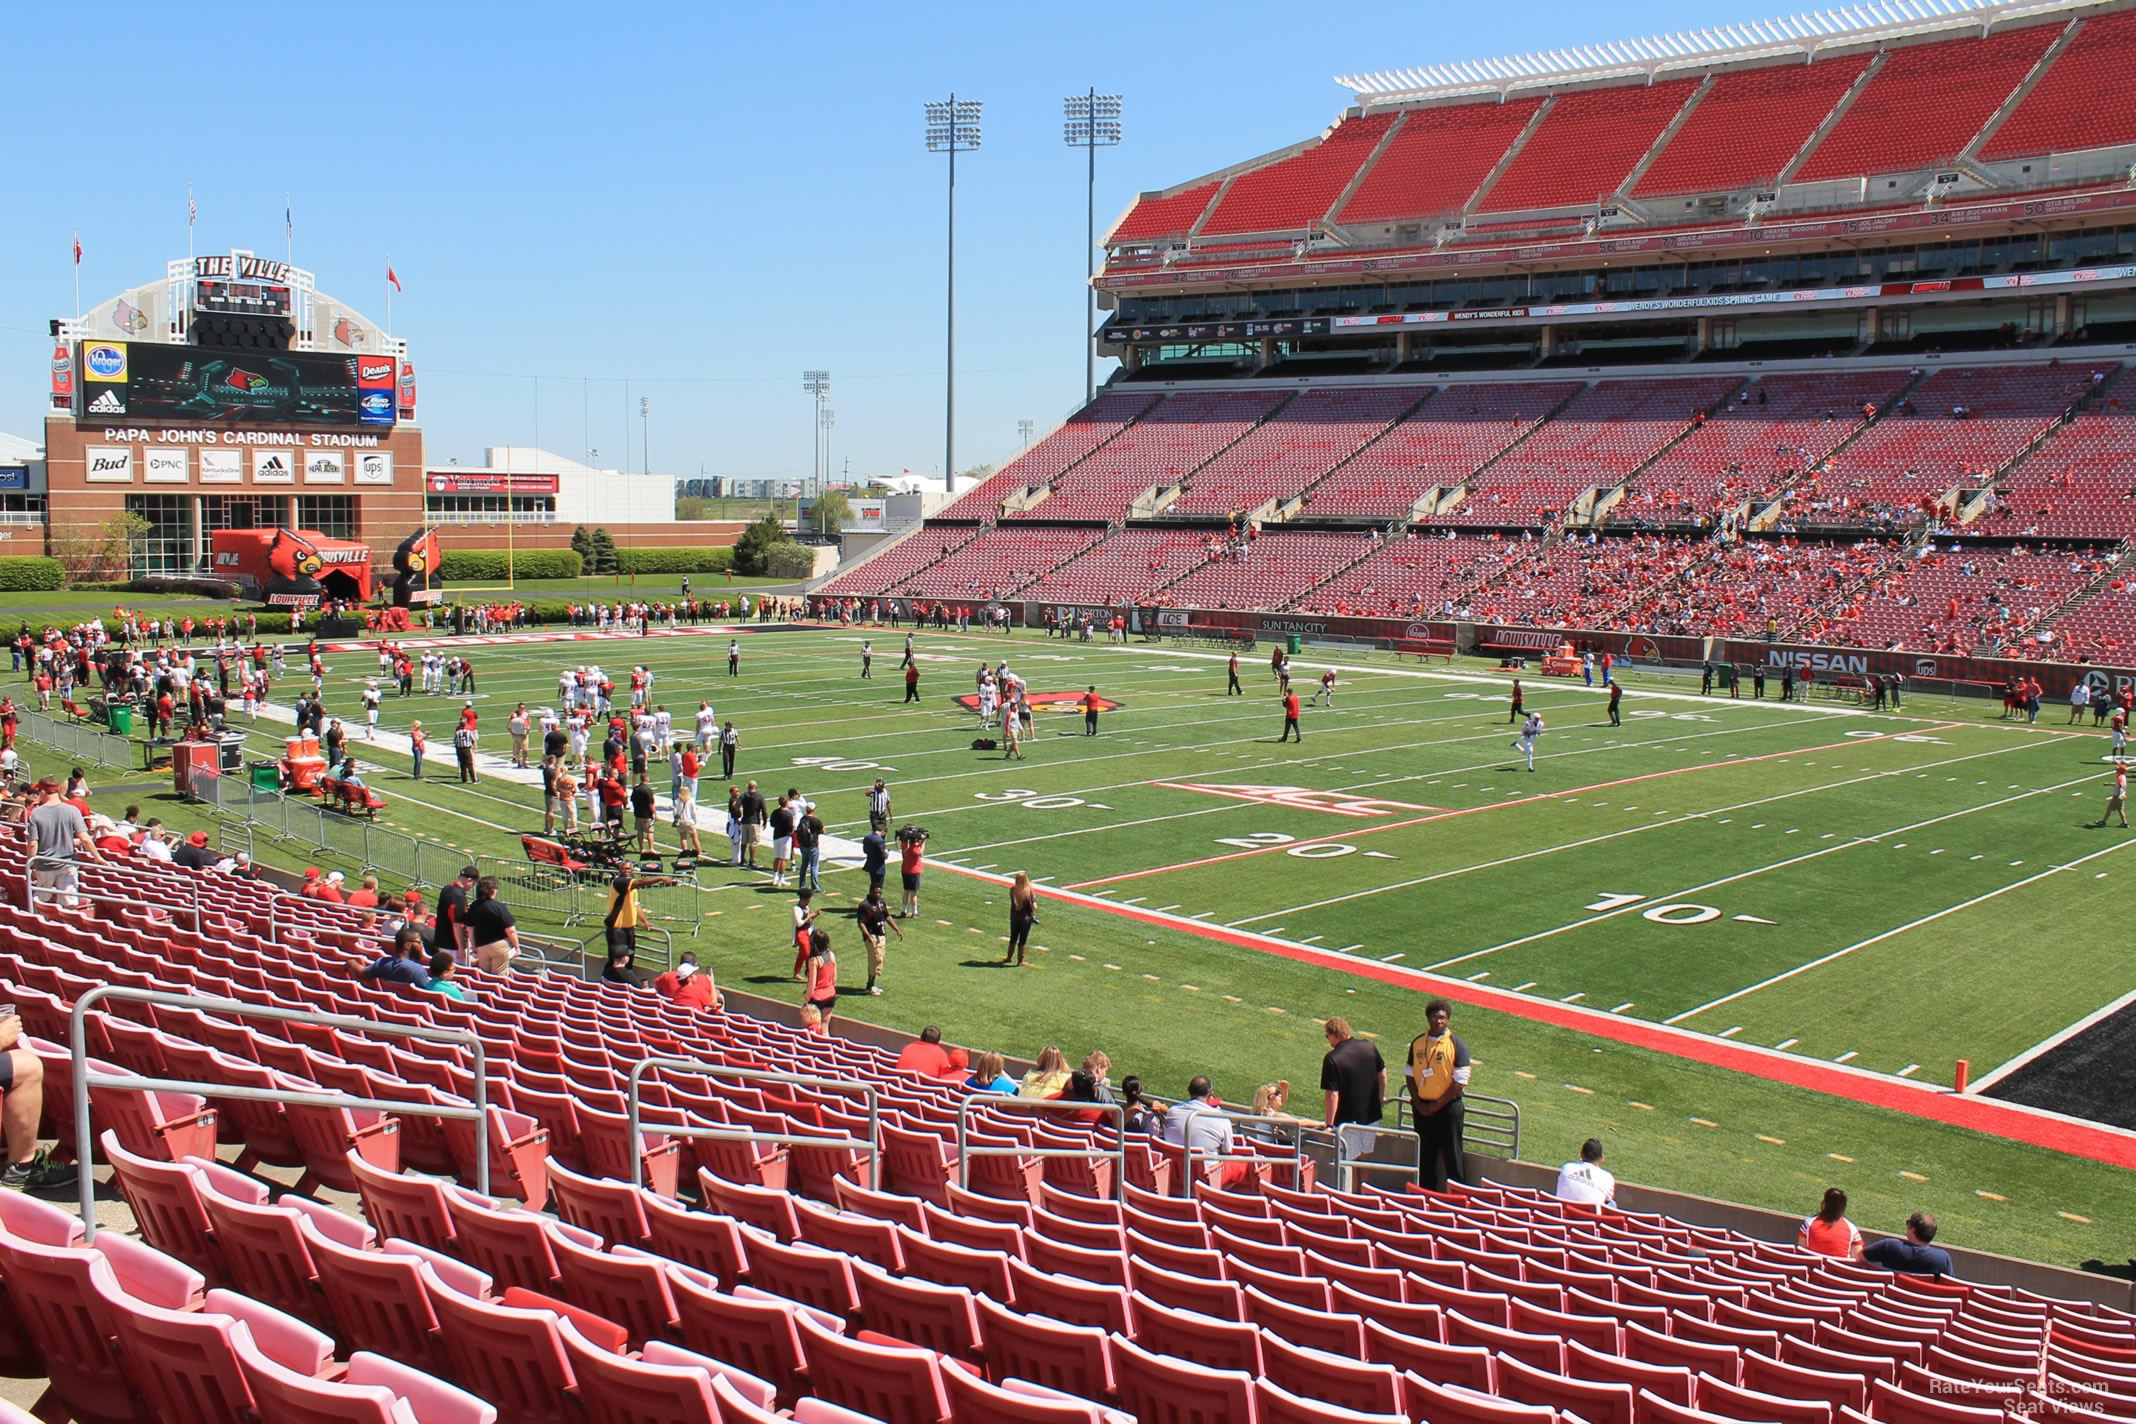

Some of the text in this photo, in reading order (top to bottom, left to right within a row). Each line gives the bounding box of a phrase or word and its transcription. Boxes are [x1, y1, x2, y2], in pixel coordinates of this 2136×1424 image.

[2063, 197, 2091, 205] WILSON
[1967, 206, 2008, 216] BUCHANAN
[2024, 202, 2044, 216] 50
[1872, 217, 1898, 225] JACOBY
[1931, 212, 1949, 224] 34
[1764, 224, 1827, 235] DWAYNE WOODRUFF
[1841, 222, 1857, 233] 75
[1697, 232, 1733, 241] ARMSTRONG
[1750, 231, 1763, 241] 10
[1599, 242, 1615, 253] 56
[1632, 238, 1649, 246] KNOP
[1661, 238, 1676, 249] 77
[1443, 255, 1458, 265] 50
[1471, 251, 1497, 259] JACKSON
[197, 256, 290, 283] THE VILLE
[1363, 260, 1377, 271] 55
[1172, 274, 1185, 284] 42
[1224, 271, 1238, 280] 26
[1096, 279, 1106, 288] 16
[1628, 300, 1660, 312] WENDY'S
[1661, 298, 1705, 310] WONDERFUL
[1706, 296, 1723, 307] KIDS
[1724, 294, 1753, 306] SPRING
[1755, 293, 1778, 304] GAME
[1454, 309, 1525, 320] WENDY'S WONDERFUL KIDS
[91, 350, 122, 373] Kroger
[362, 363, 392, 378] Dean's
[88, 404, 126, 414] adidas
[105, 428, 378, 447] PAPA JOHN'S CARDINAL STADIUM
[91, 455, 128, 472] Bud
[161, 460, 183, 469] PNC
[365, 463, 382, 475] ups
[258, 469, 289, 477] adidas
[269, 593, 320, 606] LOUISVILLE
[1077, 607, 1113, 619] NORTON
[1262, 620, 1327, 633] SUN TAN CITY
[1408, 627, 1428, 639] Kroger
[1496, 630, 1562, 649] LOUISVILLE
[1768, 650, 1867, 673] NISSAN
[1917, 665, 1936, 677] ups
[642, 720, 652, 729] 67
[790, 756, 881, 771] 40
[974, 788, 1086, 810] 30
[1213, 832, 1358, 858] 20
[1583, 892, 1723, 925] 10
